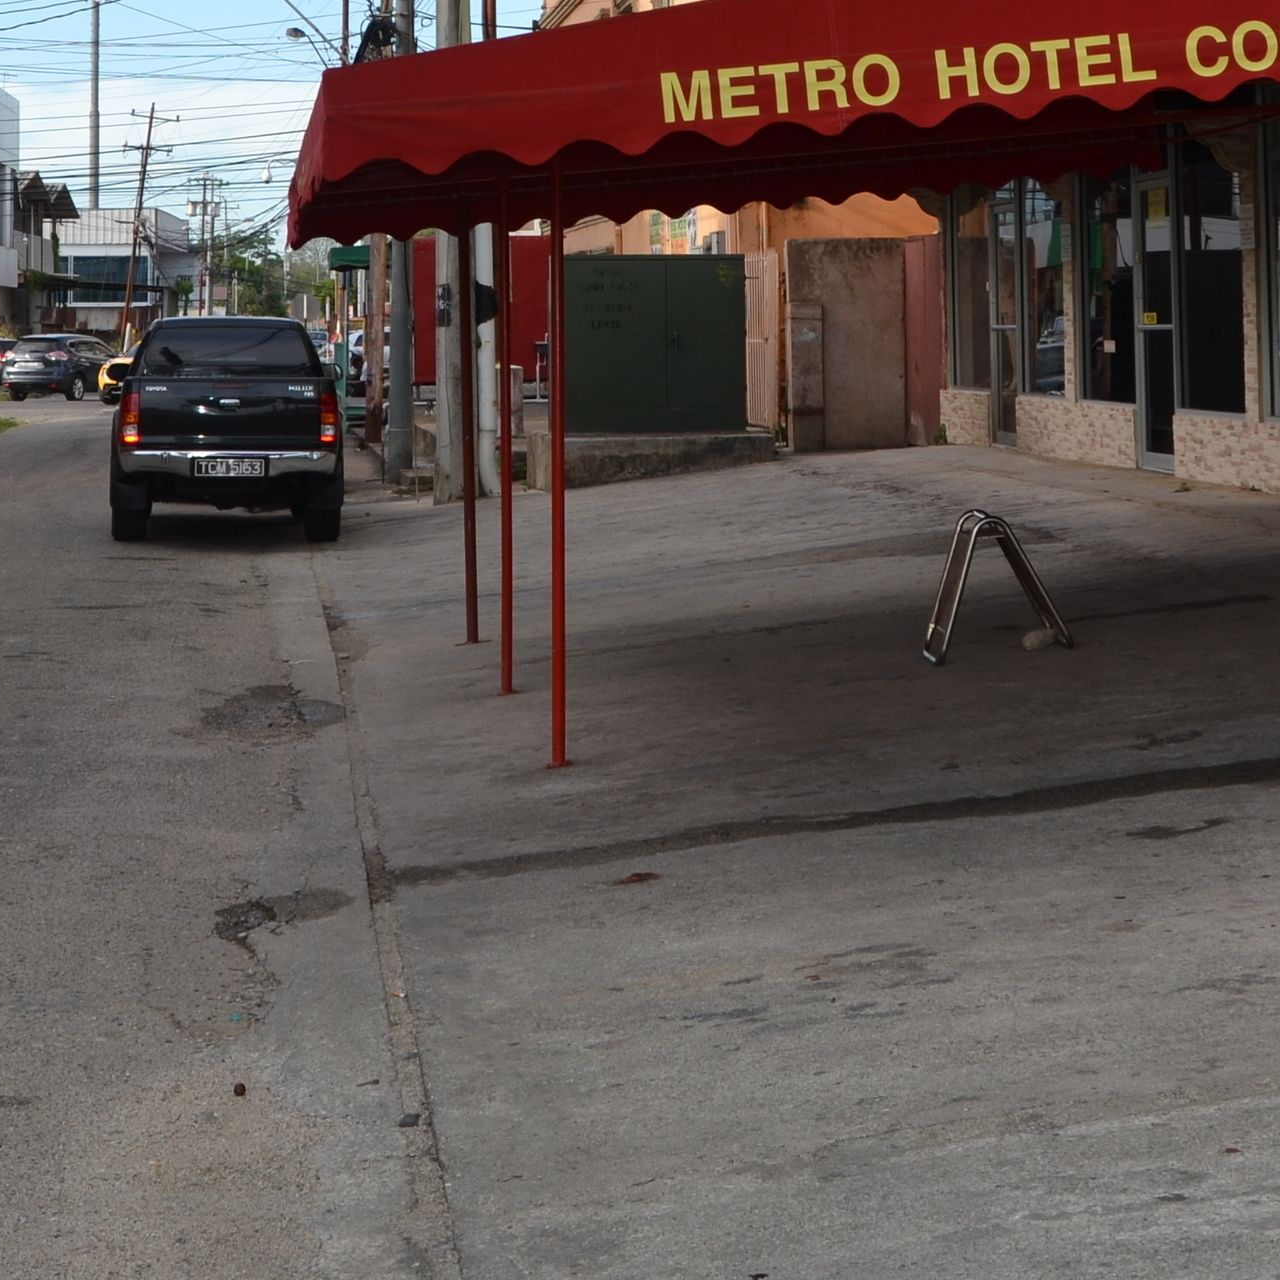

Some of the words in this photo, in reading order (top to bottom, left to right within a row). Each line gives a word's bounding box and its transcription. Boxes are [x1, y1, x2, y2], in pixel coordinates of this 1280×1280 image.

[660, 51, 901, 123] METRO
[934, 32, 1157, 100] HOTEL
[199, 460, 227, 474] TCM
[230, 460, 261, 474] 5163
